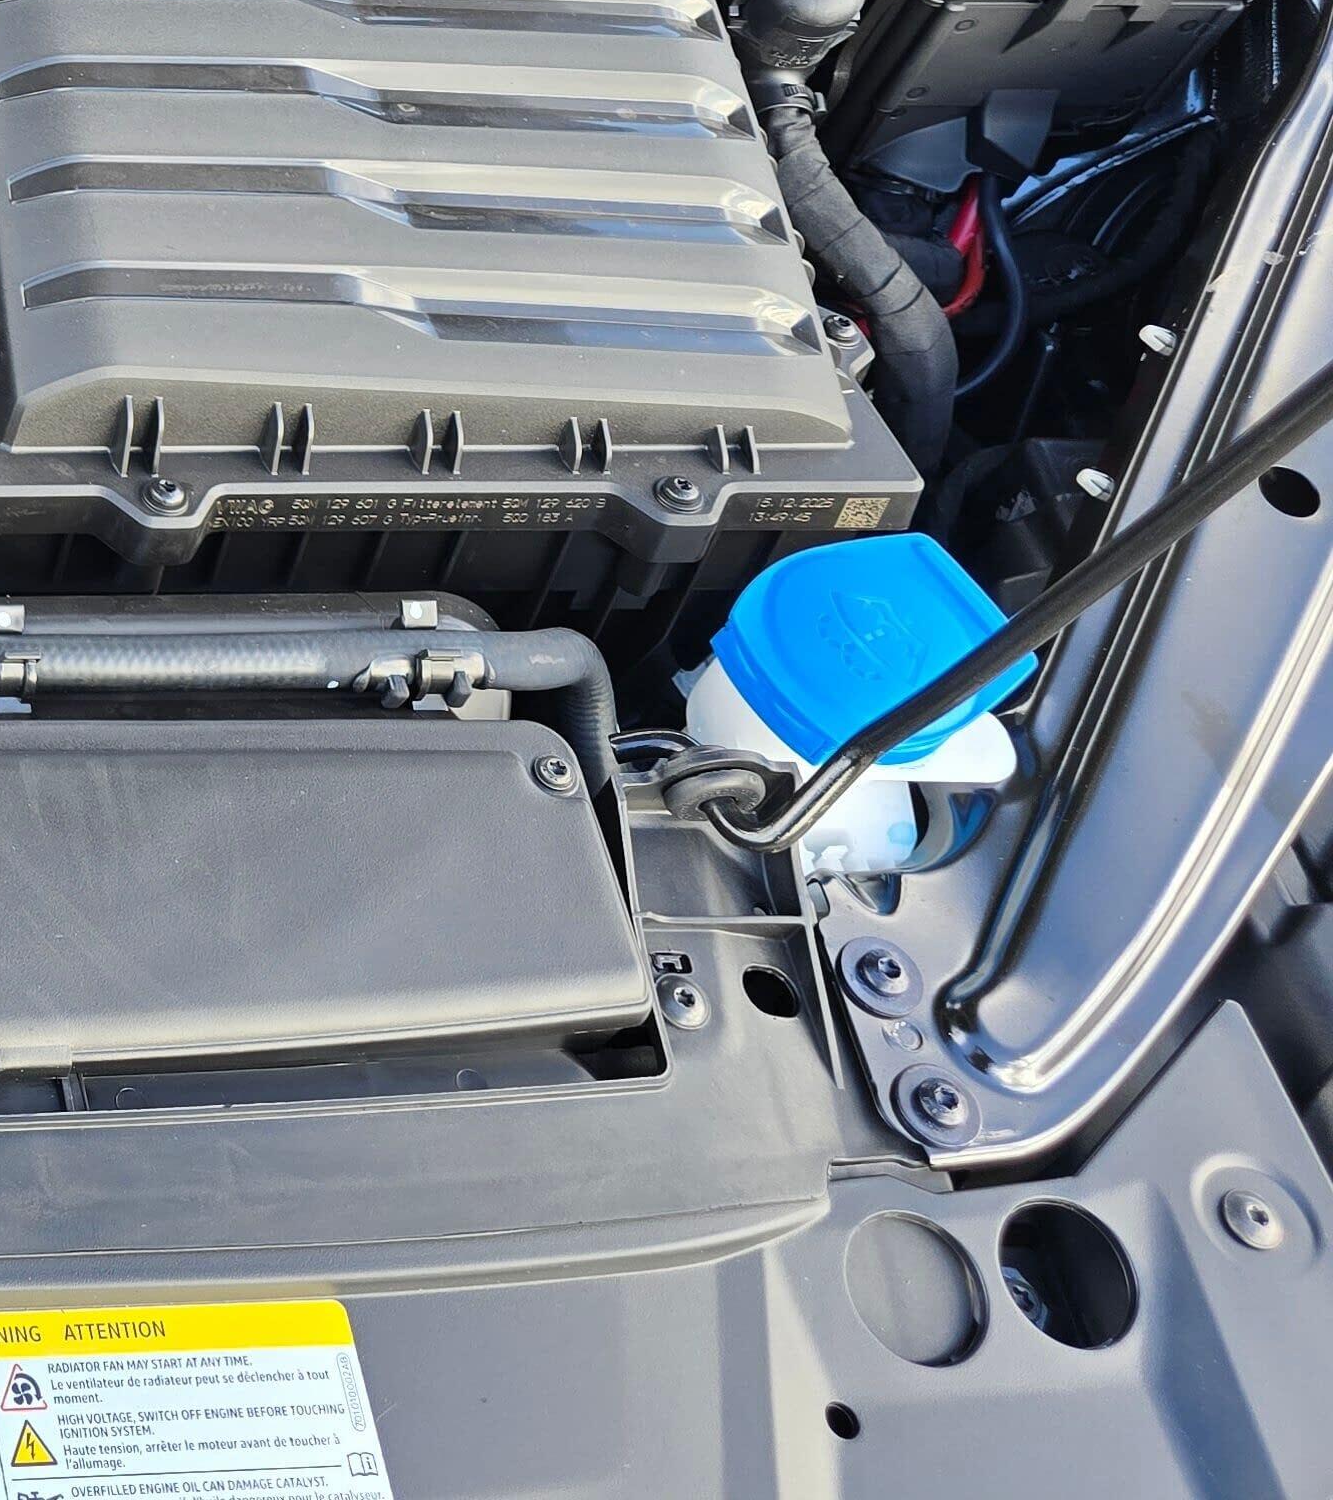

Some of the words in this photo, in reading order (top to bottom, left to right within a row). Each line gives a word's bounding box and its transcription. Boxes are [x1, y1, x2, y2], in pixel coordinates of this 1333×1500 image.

[325, 499, 350, 510] 129
[536, 498, 561, 509] 129
[322, 515, 346, 525] 129
[65, 1320, 166, 1341] ATTENTION
[48, 1361, 100, 1373] RADIATOR
[103, 1360, 124, 1371] FAN
[127, 1360, 148, 1370] MAY
[151, 1358, 182, 1369] START
[186, 1358, 197, 1368] AT
[201, 1356, 221, 1368] ANY
[224, 1356, 253, 1366] TIME.
[51, 1379, 64, 1390] Le
[66, 1376, 124, 1390] ventilateur
[127, 1376, 141, 1387] de
[143, 1374, 192, 1386] radiateur
[195, 1374, 220, 1387] peut
[223, 1374, 234, 1383] se
[237, 1370, 295, 1383] déclencher
[298, 1369, 304, 1380] à
[307, 1370, 330, 1380] tout
[54, 1393, 103, 1404] moment.
[57, 1414, 84, 1425] HIGH
[87, 1412, 136, 1425] VOLTAGE,
[138, 1410, 179, 1422] SWITCH
[181, 1409, 202, 1420] OFF
[205, 1408, 244, 1419] ENGINE
[247, 1406, 288, 1418] BEFORE
[291, 1403, 345, 1416] TOUCHING
[60, 1427, 108, 1439] IGNITION
[111, 1425, 155, 1437] SYSTEM.
[63, 1445, 96, 1456] Haute
[99, 1442, 142, 1455] tension,
[145, 1440, 181, 1452] arrêter
[185, 1440, 195, 1451] le
[198, 1440, 237, 1450] moteur
[241, 1438, 271, 1448] avant
[274, 1436, 287, 1447] de
[289, 1434, 331, 1447] toucher
[333, 1432, 340, 1444] à
[66, 1457, 126, 1471] l'allumage.
[71, 1484, 136, 1498] OVERFILLED
[139, 1482, 180, 1494] ENGINE
[183, 1481, 200, 1492] OIL
[203, 1481, 225, 1492] CAN
[228, 1478, 273, 1491] DAMAGE
[276, 1476, 328, 1488] CATALYST.
